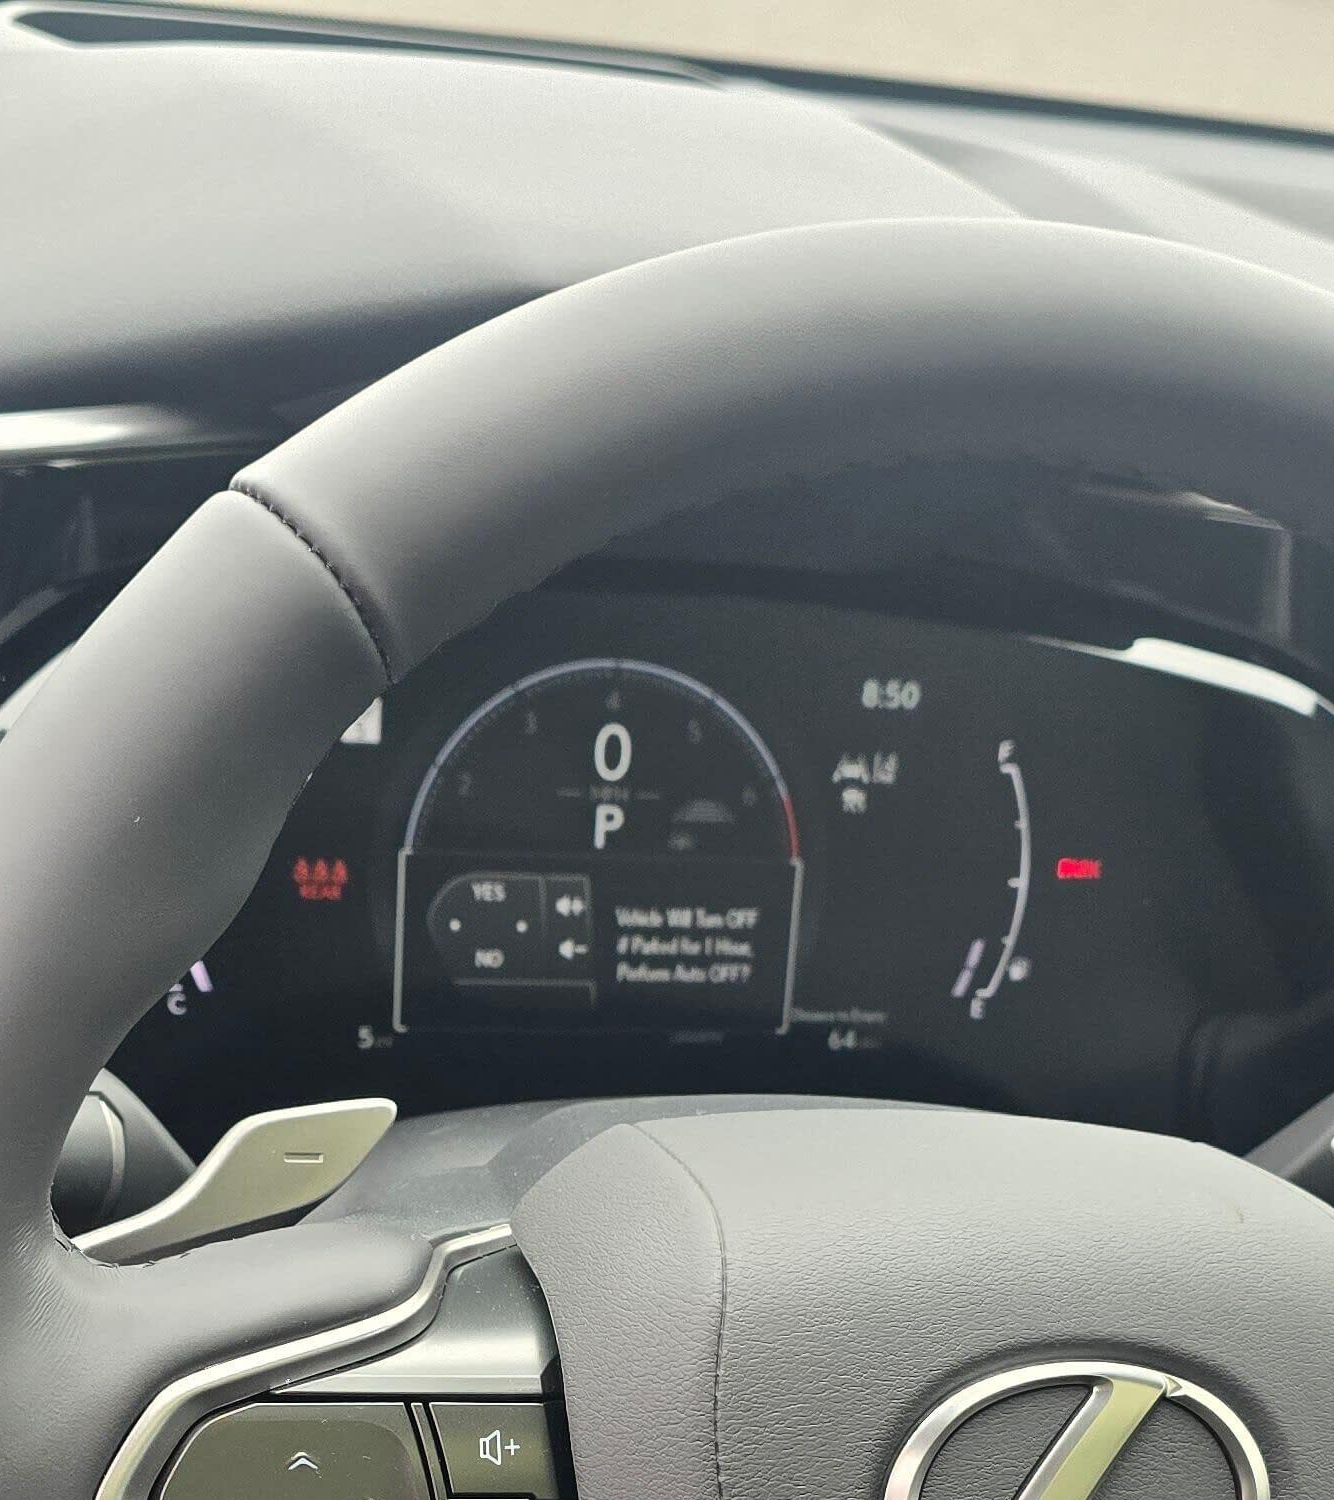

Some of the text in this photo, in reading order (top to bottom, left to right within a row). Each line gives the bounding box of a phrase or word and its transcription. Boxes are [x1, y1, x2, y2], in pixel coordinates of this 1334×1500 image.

[862, 678, 921, 710] 8:50
[594, 722, 632, 782] 0
[593, 803, 625, 849] P
[472, 881, 507, 902] YES
[474, 949, 504, 969] NO
[357, 1025, 375, 1050] 5
